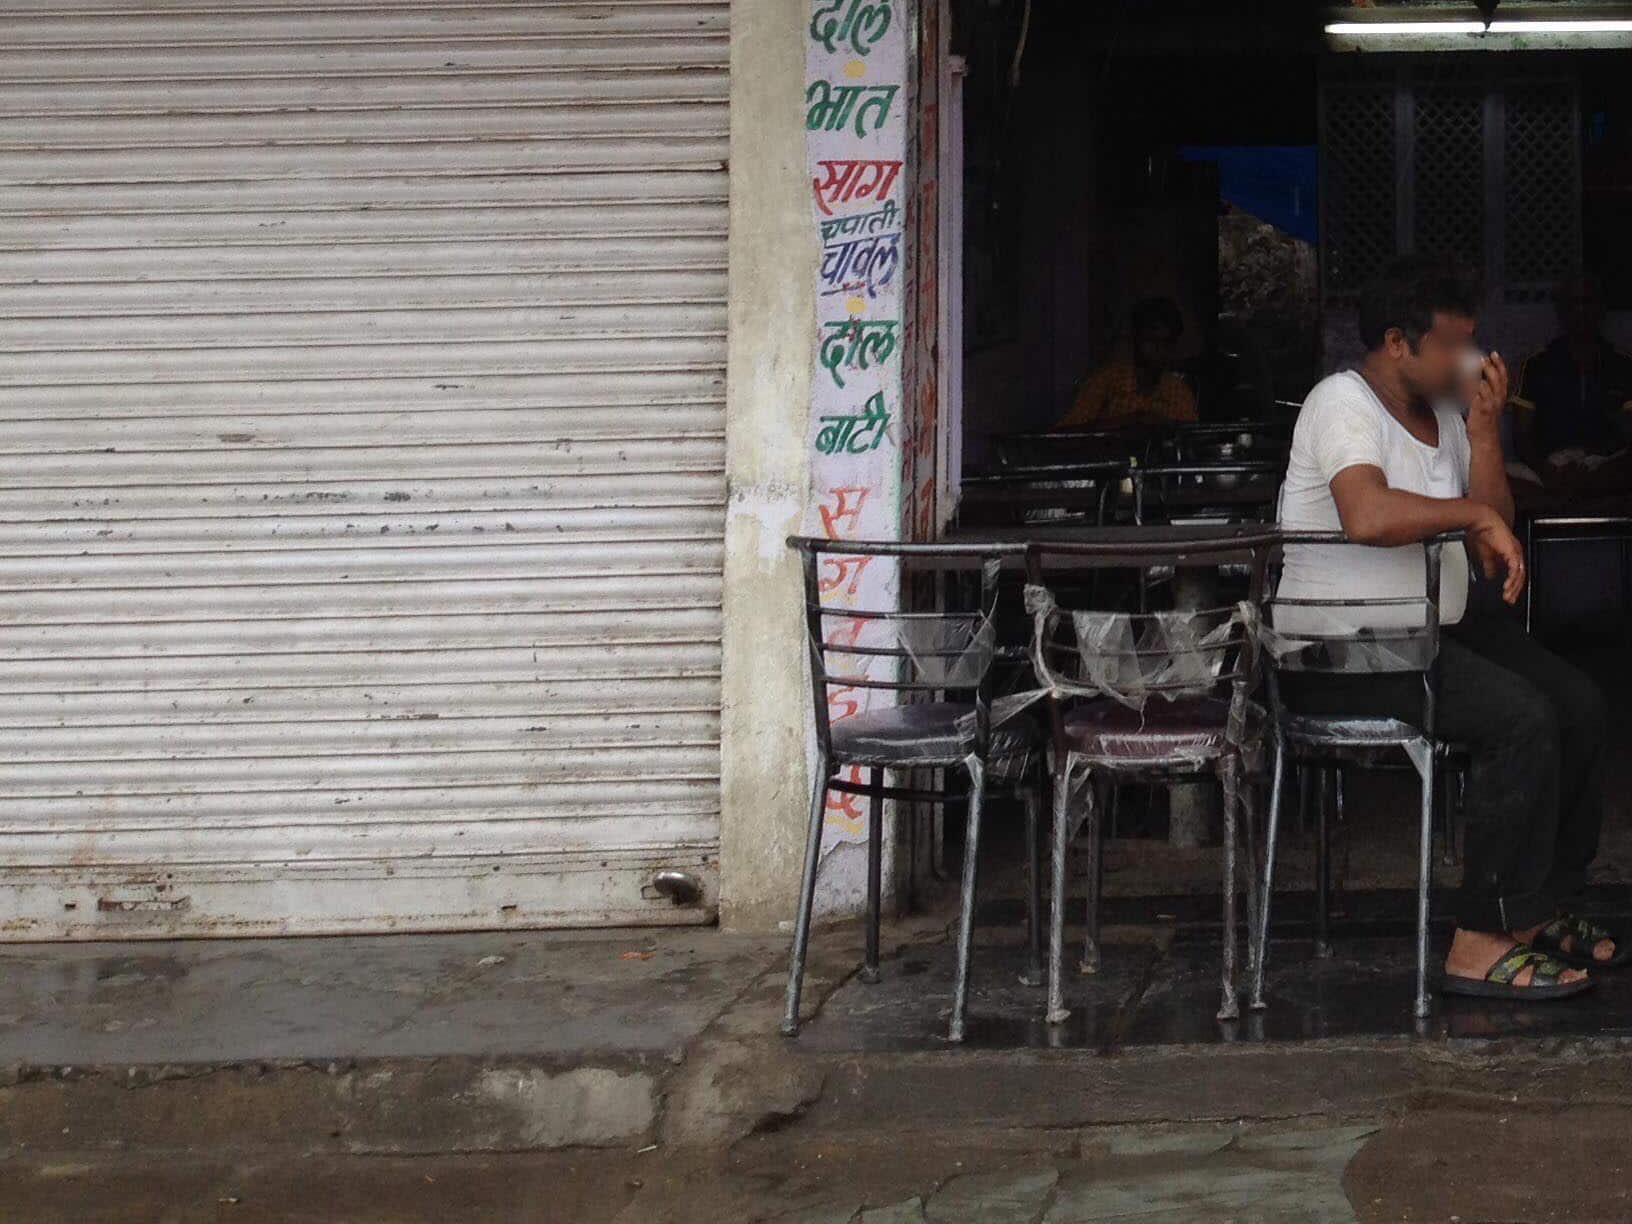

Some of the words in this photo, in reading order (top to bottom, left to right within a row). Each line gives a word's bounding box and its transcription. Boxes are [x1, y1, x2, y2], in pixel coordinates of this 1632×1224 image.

[806, 79, 900, 139] भात
[813, 161, 903, 216] साग
[818, 319, 900, 388] दाल
[815, 391, 893, 456] बाटी
